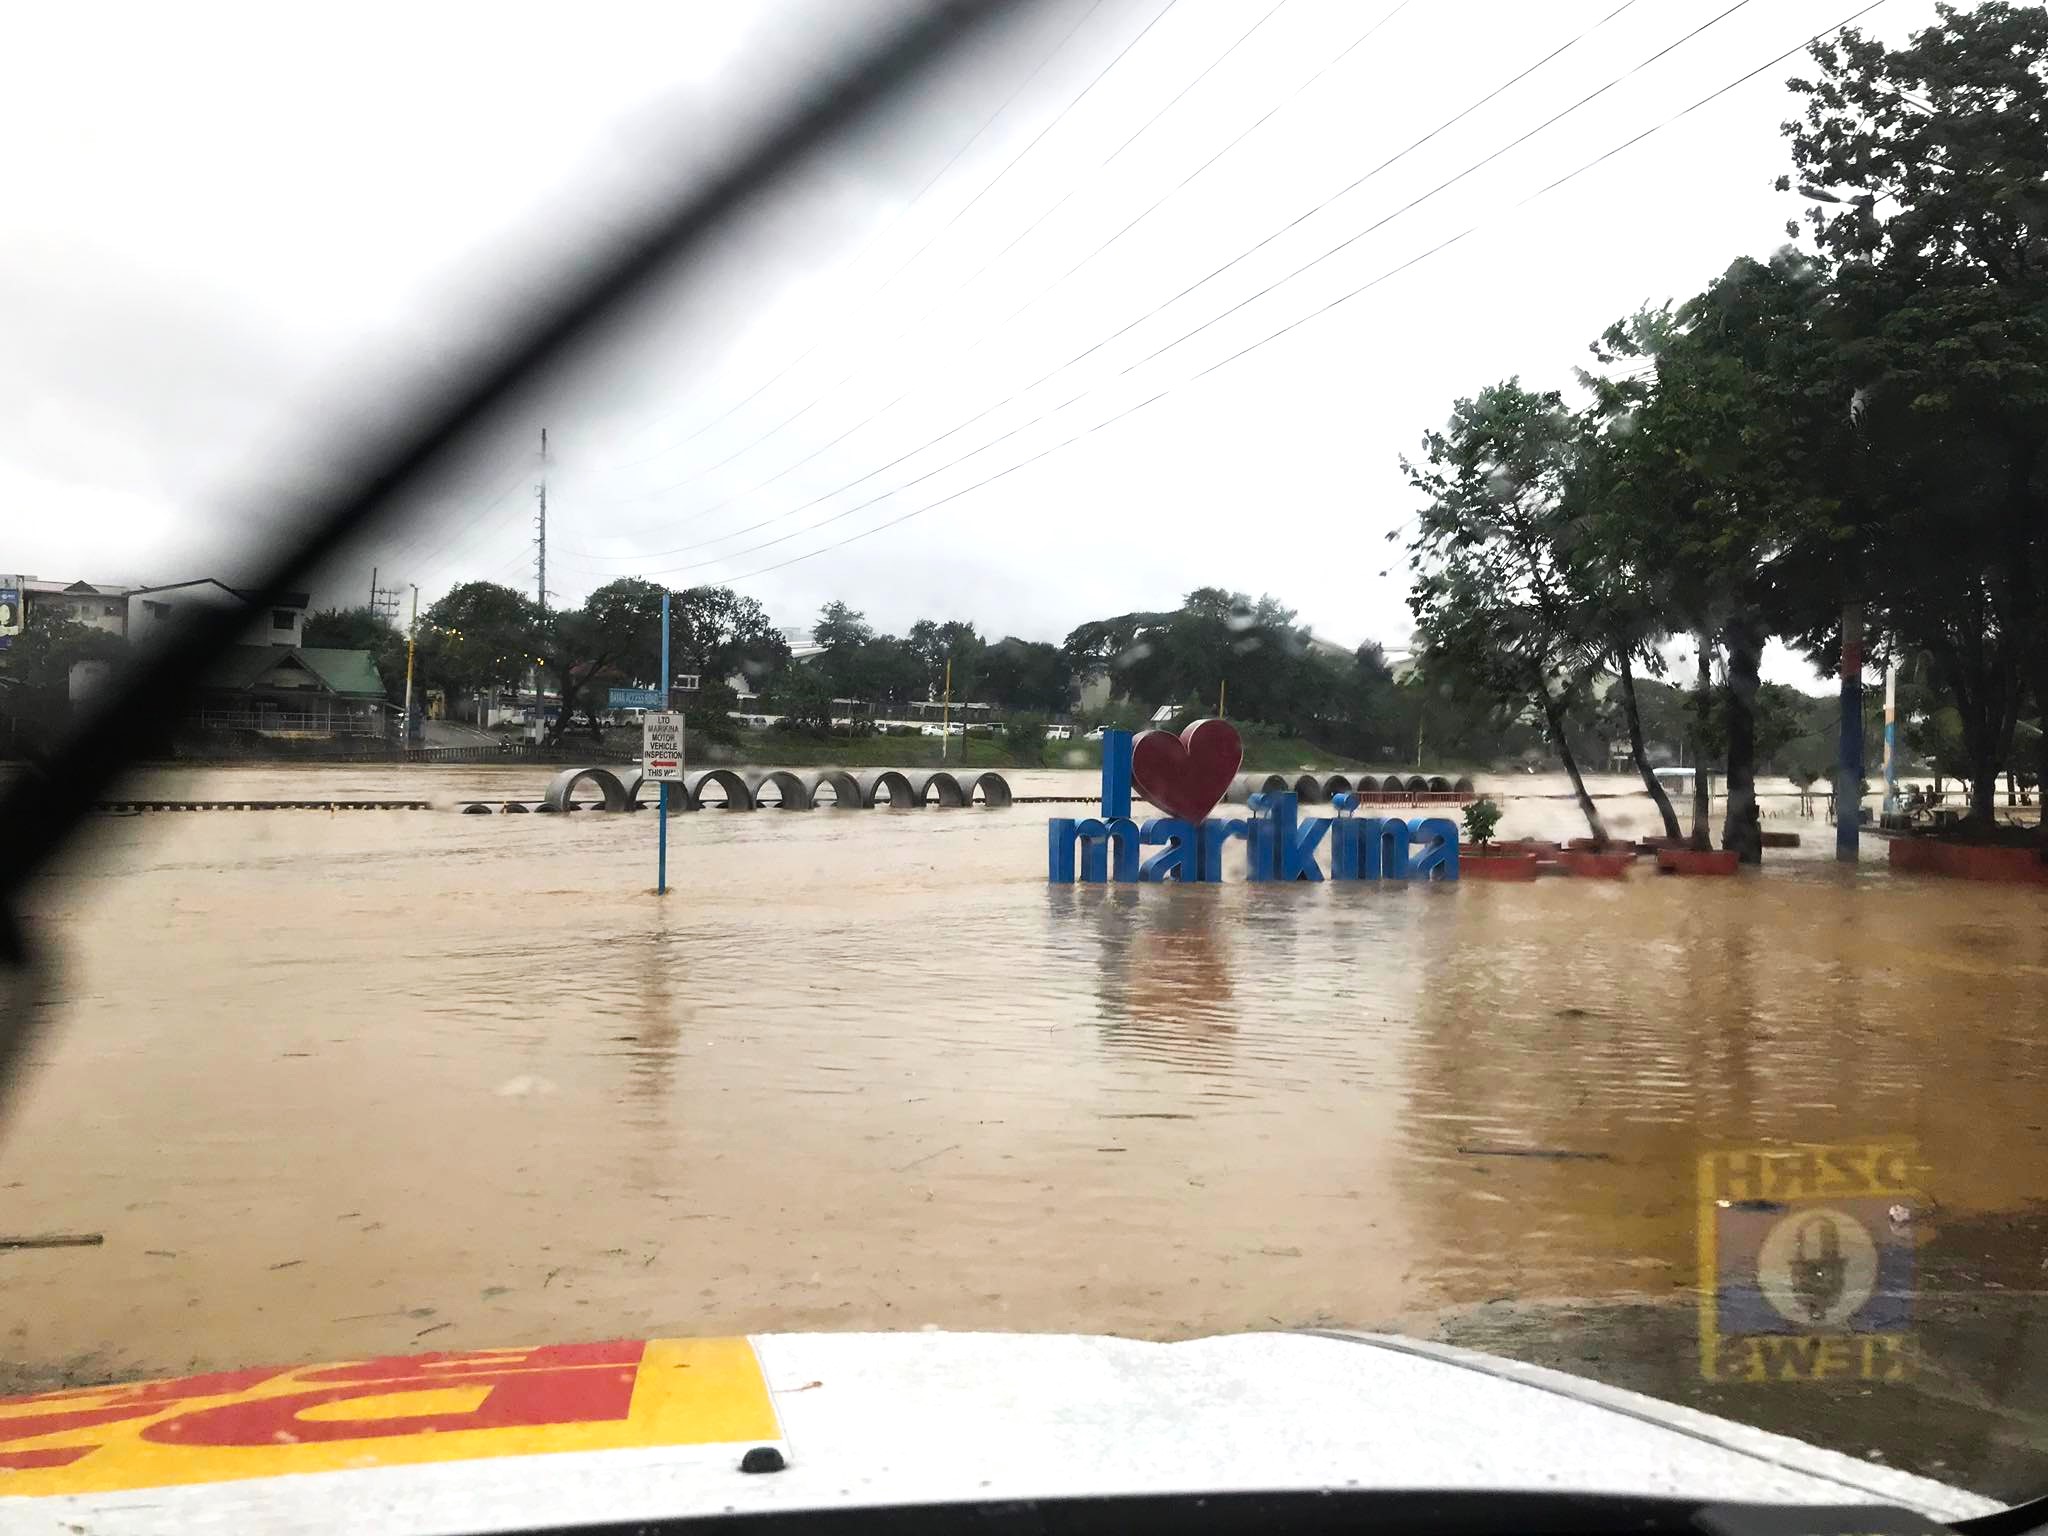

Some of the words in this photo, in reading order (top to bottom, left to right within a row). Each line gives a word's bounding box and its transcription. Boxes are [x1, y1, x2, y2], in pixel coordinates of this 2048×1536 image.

[657, 716, 670, 724] LTO
[652, 733, 675, 742] MOTOR
[650, 742, 678, 750] VEHICLE
[644, 750, 682, 759] INSPECTION
[648, 768, 663, 777] THIS
[1048, 792, 1460, 882] marikina
